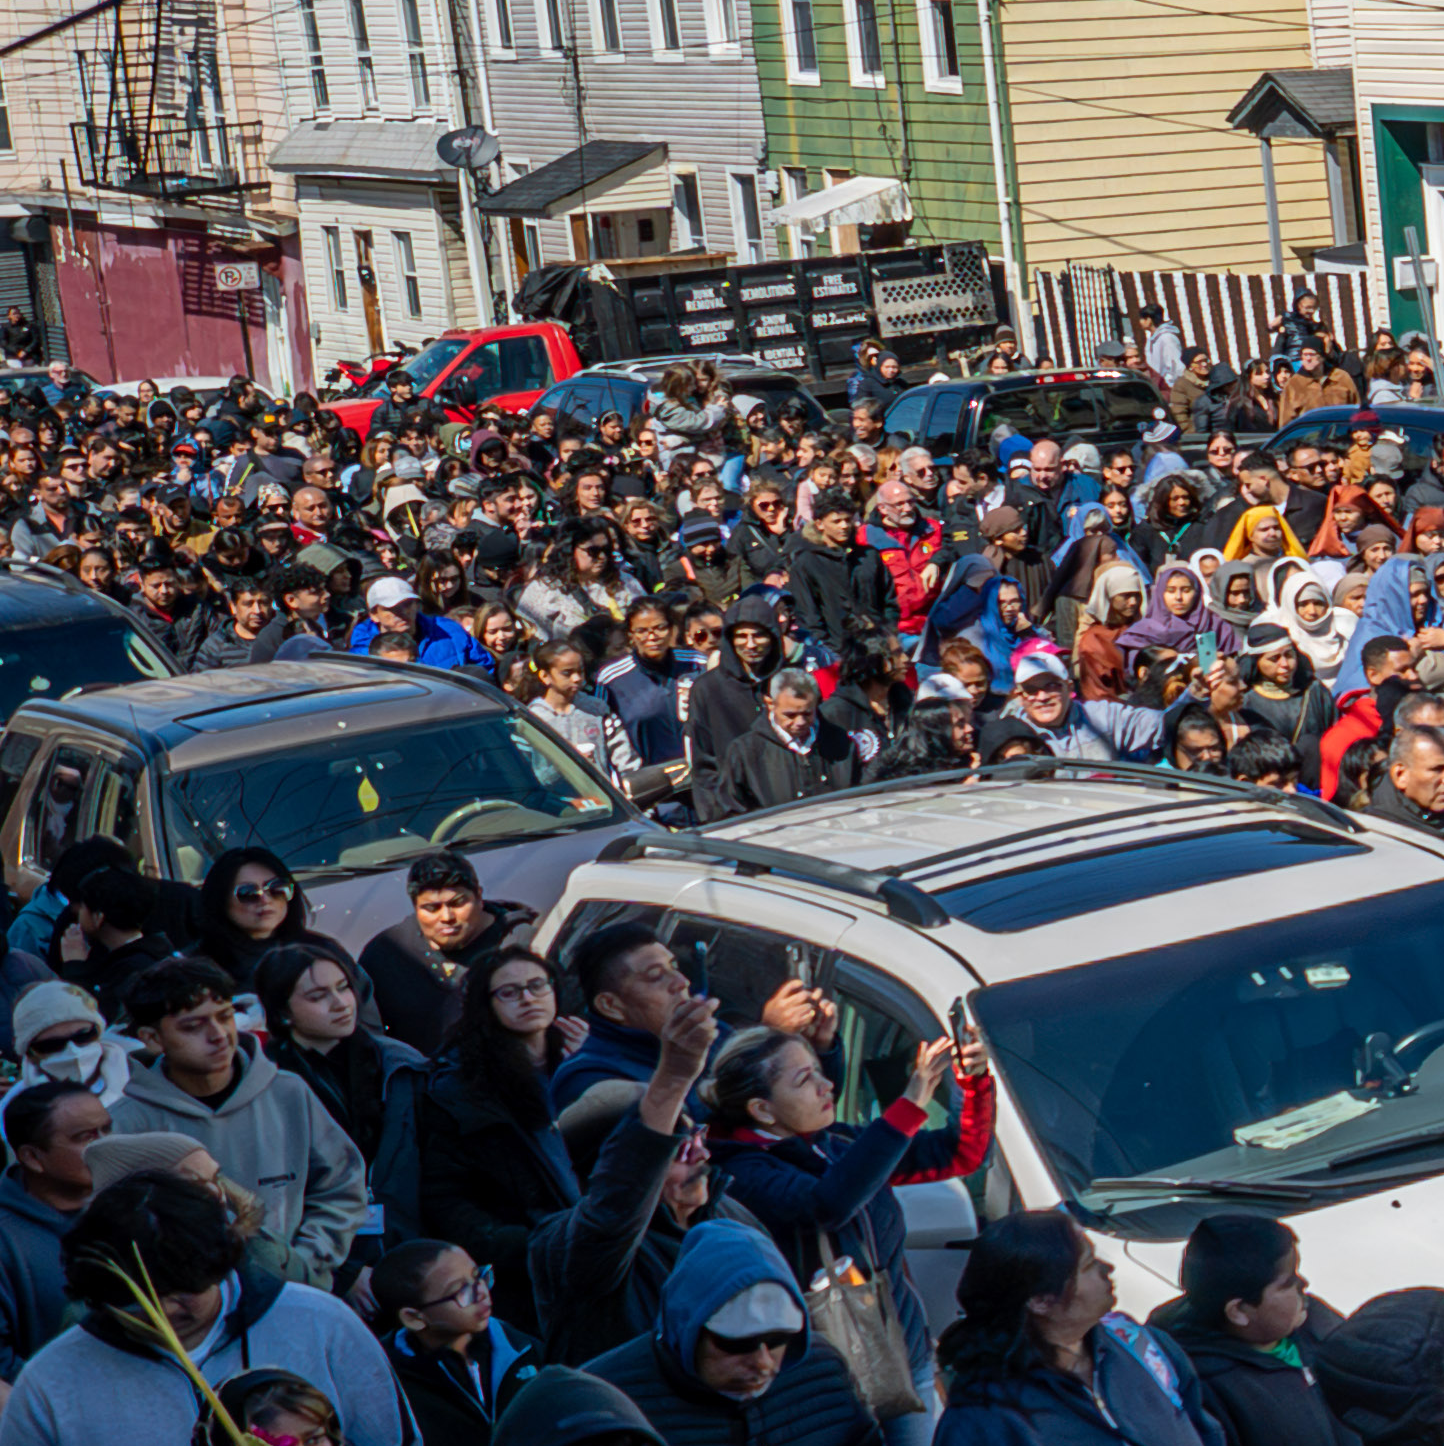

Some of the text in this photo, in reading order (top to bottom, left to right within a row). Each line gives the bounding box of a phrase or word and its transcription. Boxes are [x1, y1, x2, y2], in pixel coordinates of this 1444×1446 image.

[822, 274, 843, 286] FREE
[812, 283, 858, 298] ESTIMATES
[685, 297, 728, 312] REMOVAL
[760, 314, 787, 326] SNOW
[755, 323, 796, 338] REMOVAL
[691, 331, 728, 346] SERVICES
